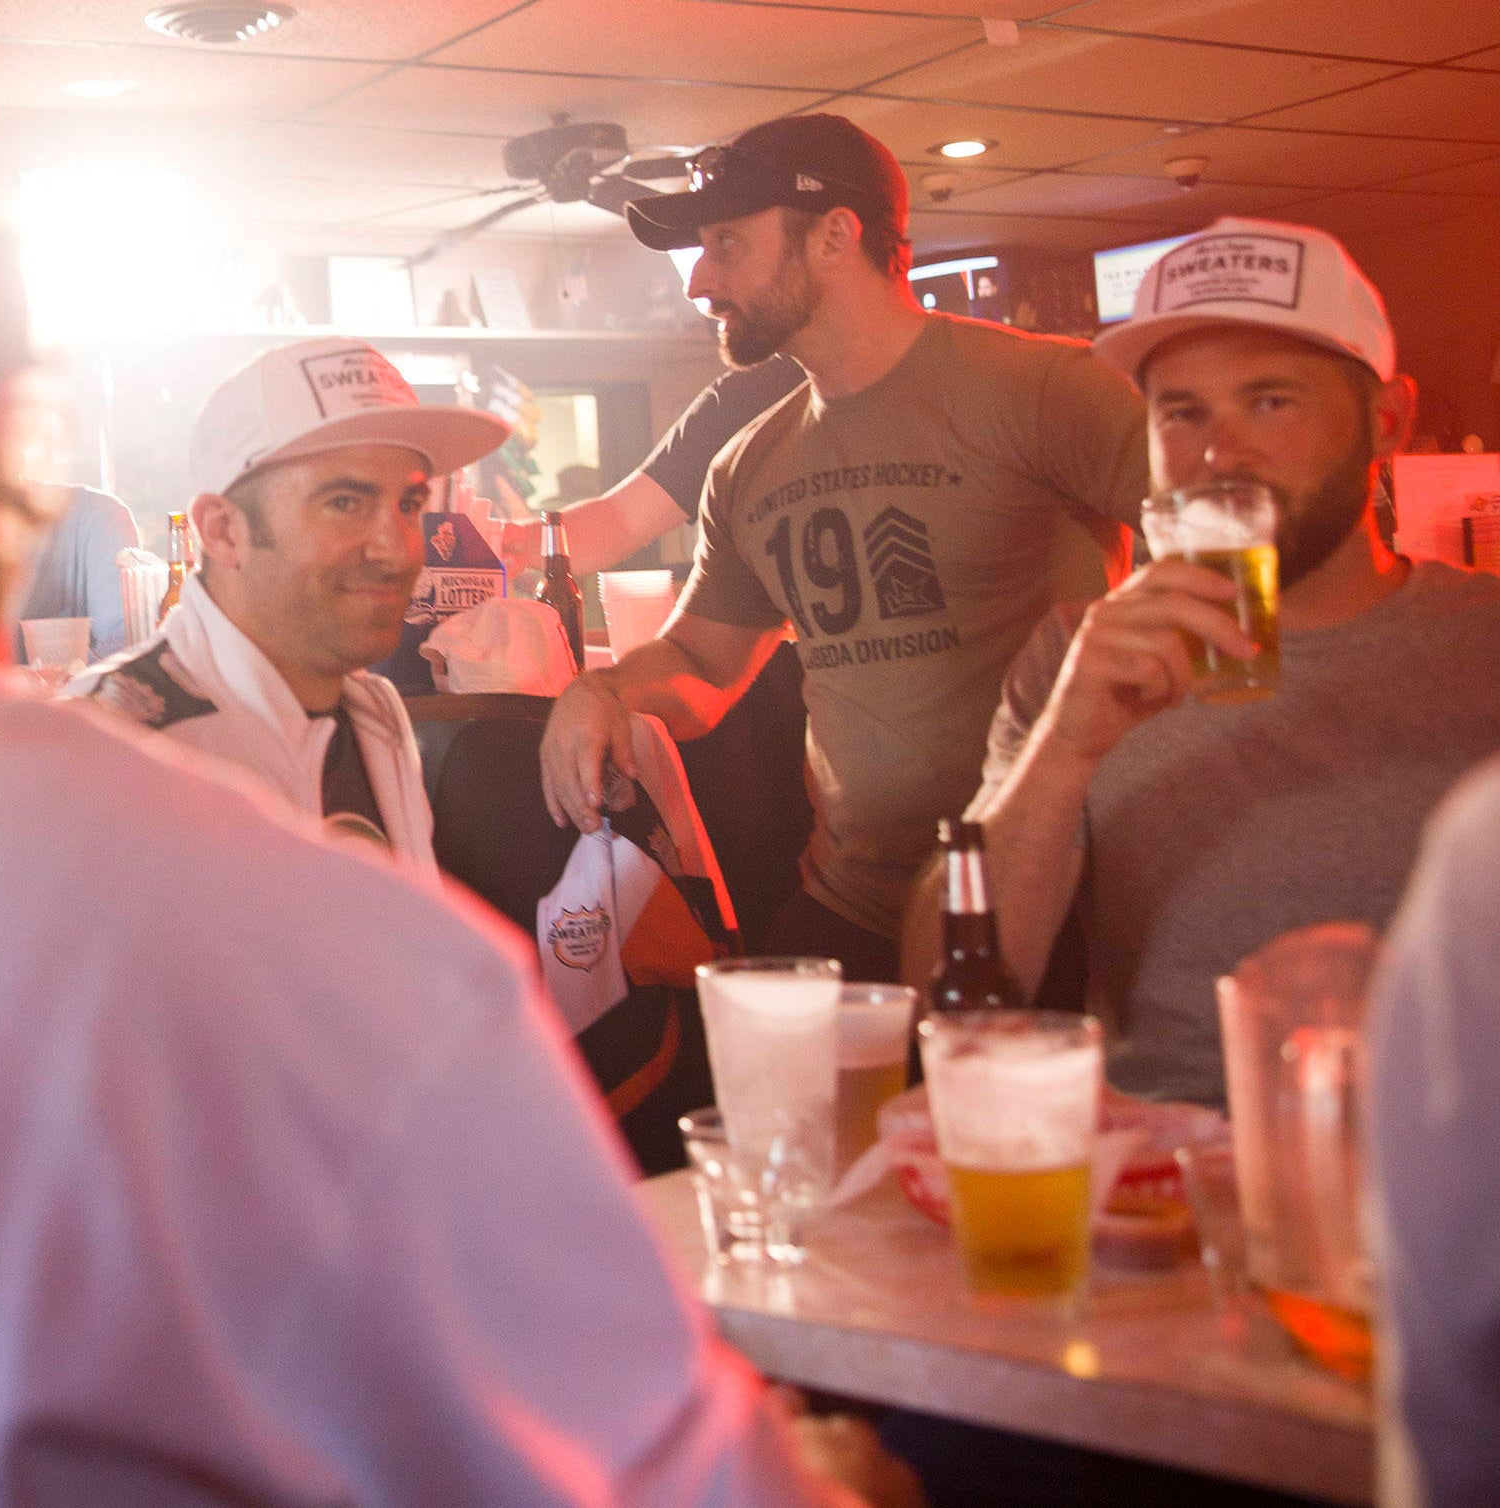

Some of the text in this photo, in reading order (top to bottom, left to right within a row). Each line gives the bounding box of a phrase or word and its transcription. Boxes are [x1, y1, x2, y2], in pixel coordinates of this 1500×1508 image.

[1166, 254, 1289, 284] SWEATERS
[810, 465, 872, 496] STATES
[874, 462, 947, 488] HOCKEY
[441, 576, 495, 588] MICHIGAN
[765, 507, 862, 638] 19
[854, 628, 961, 665] DIVISION
